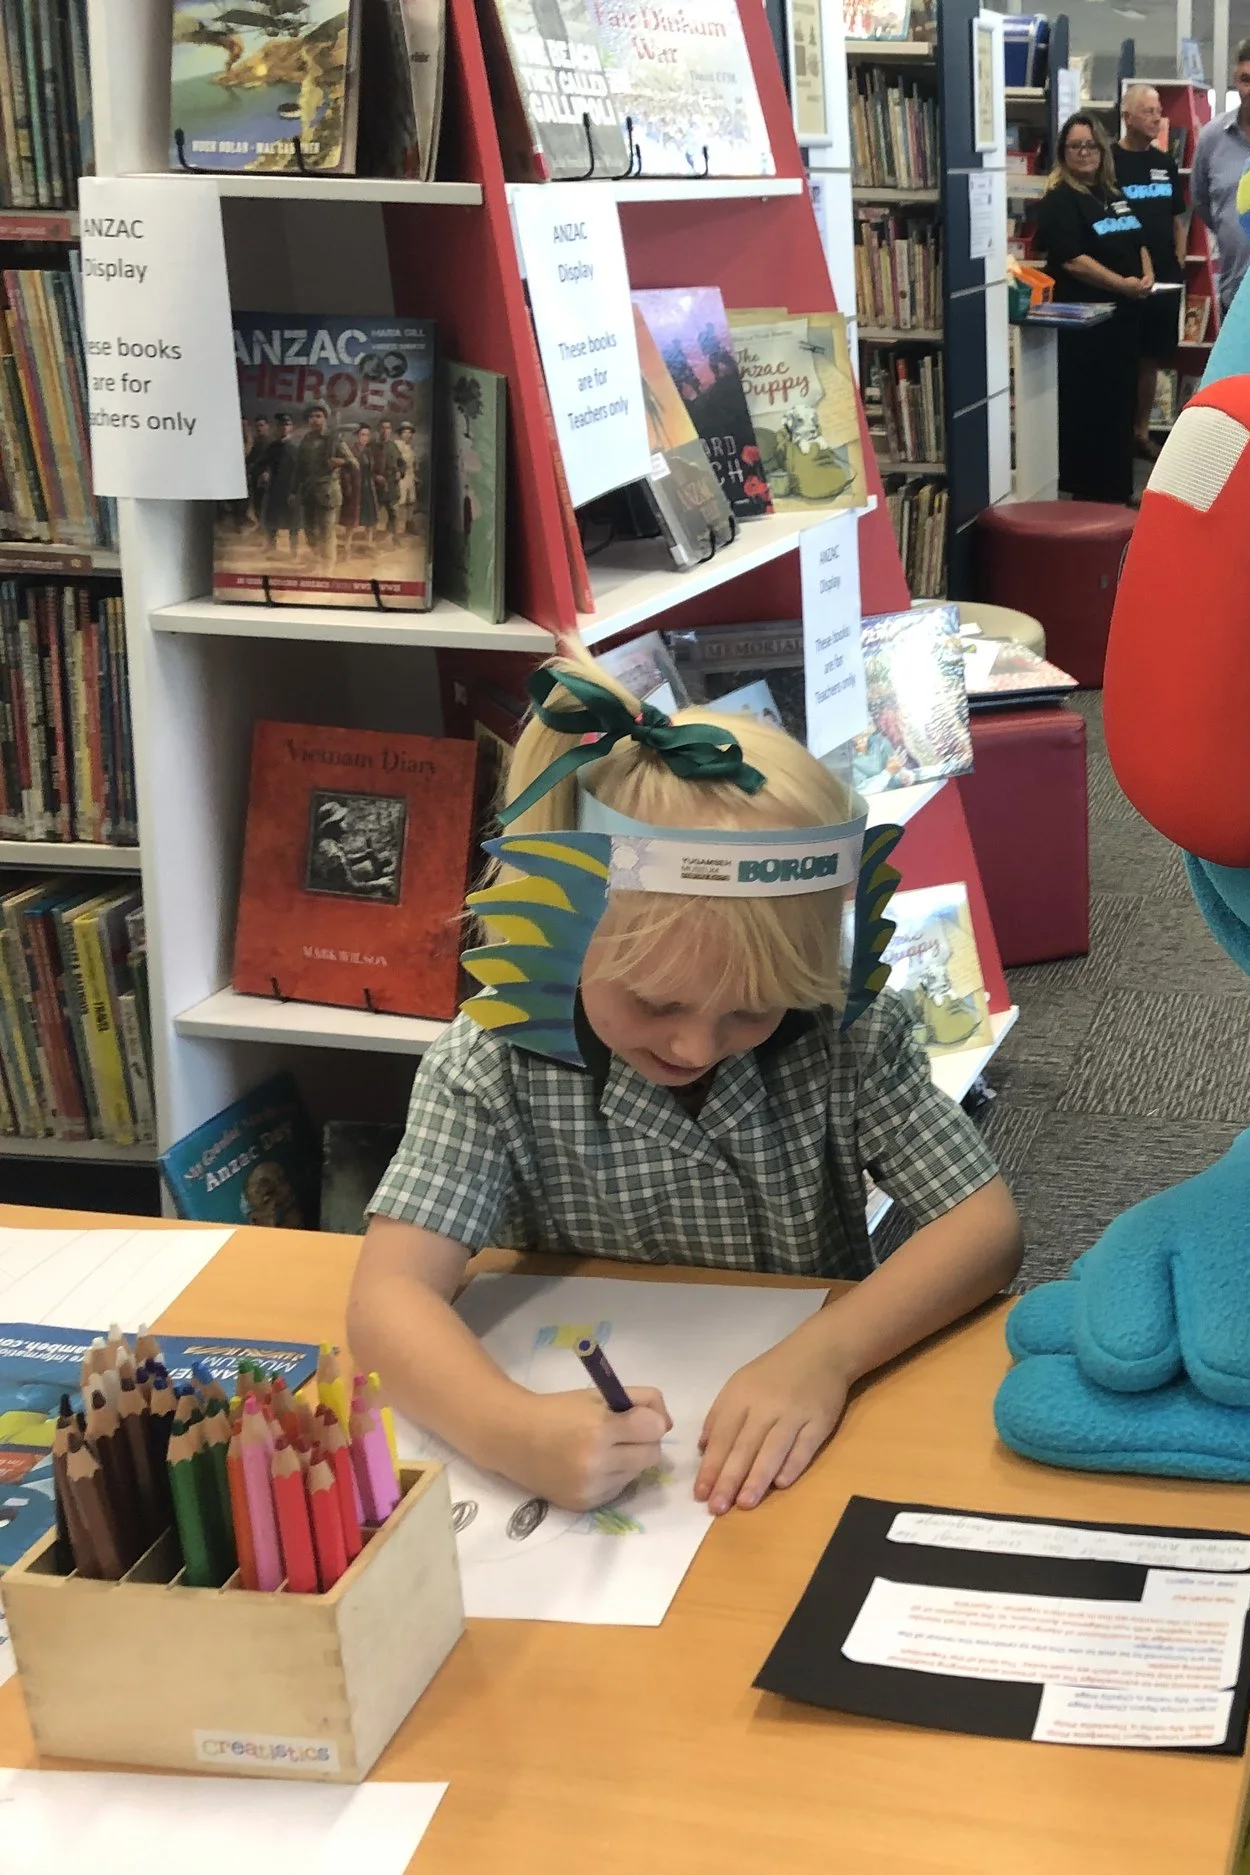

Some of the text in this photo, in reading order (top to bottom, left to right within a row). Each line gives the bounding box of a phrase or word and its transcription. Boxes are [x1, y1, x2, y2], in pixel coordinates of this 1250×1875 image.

[553, 222, 587, 244] ANZAC
[558, 261, 594, 285] Display
[117, 337, 182, 360] books
[232, 329, 369, 366] ANZAC
[558, 333, 617, 361] These books
[93, 373, 152, 393] are for
[577, 367, 609, 392] are for
[740, 362, 790, 379] nzac
[238, 363, 415, 415] HEROES
[147, 412, 197, 436] only
[567, 395, 630, 431] Teachers only
[284, 738, 438, 782] Vietnam Diary
[737, 852, 839, 884] BOROBI
